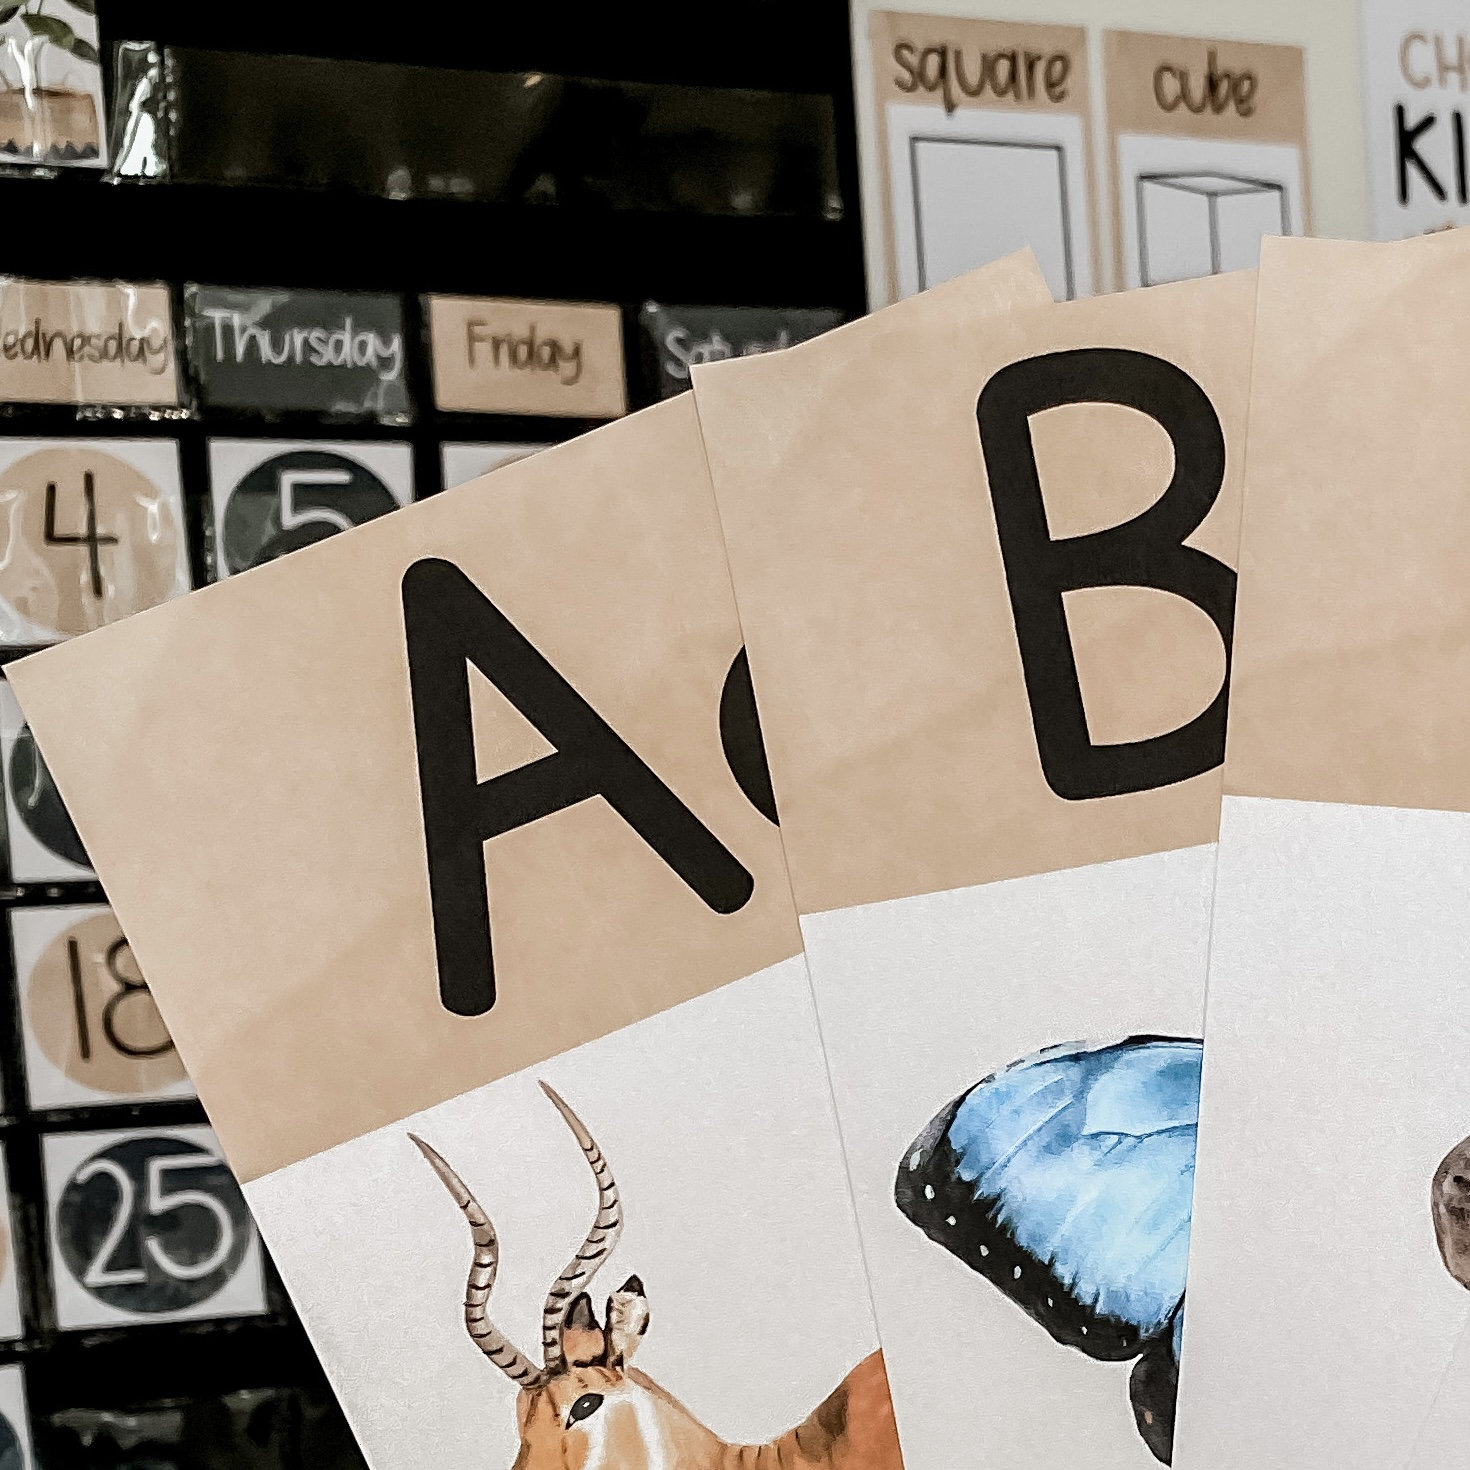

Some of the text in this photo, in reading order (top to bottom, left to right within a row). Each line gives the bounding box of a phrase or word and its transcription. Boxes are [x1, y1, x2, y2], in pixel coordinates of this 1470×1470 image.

[892, 38, 1073, 116] square
[1152, 49, 1260, 119] cube
[2, 317, 169, 375] ednesday
[200, 307, 402, 381] Thursday
[466, 318, 584, 387] Friday
[44, 470, 118, 598] 4
[976, 347, 1239, 800] B
[66, 936, 176, 1058] 18
[75, 1153, 233, 1287] 25
